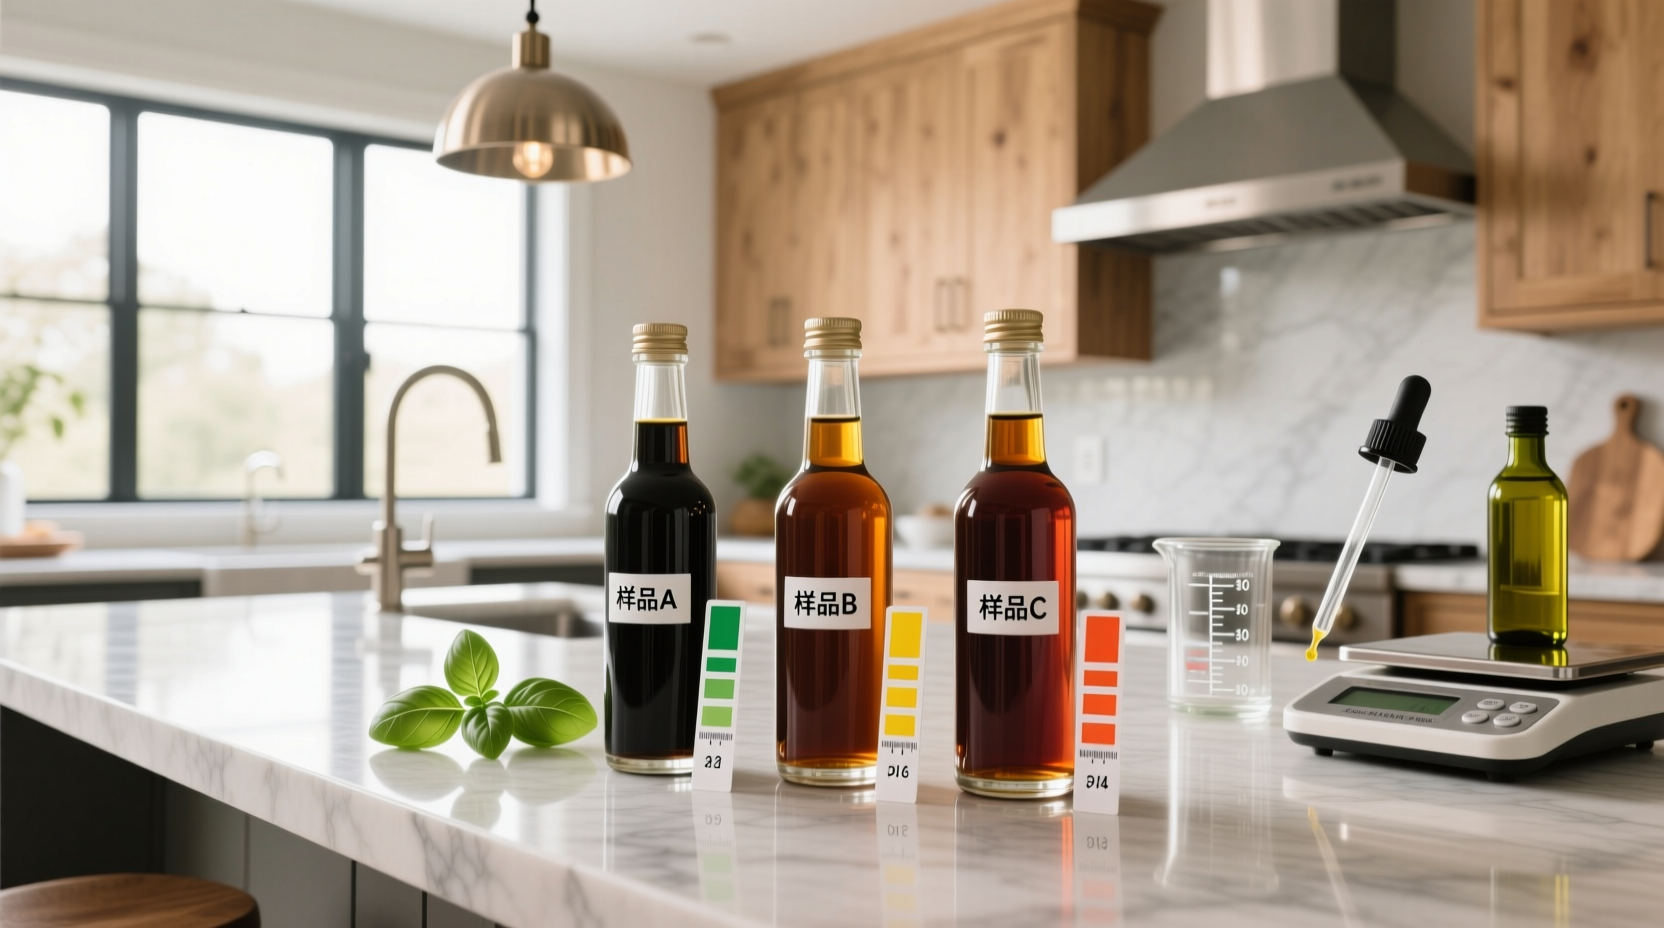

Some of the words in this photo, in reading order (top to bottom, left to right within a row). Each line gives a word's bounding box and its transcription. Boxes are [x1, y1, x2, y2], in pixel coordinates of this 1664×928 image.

[616, 585, 678, 612] 样品A
[794, 590, 858, 617] 样品B
[979, 593, 1047, 622] 样品C
